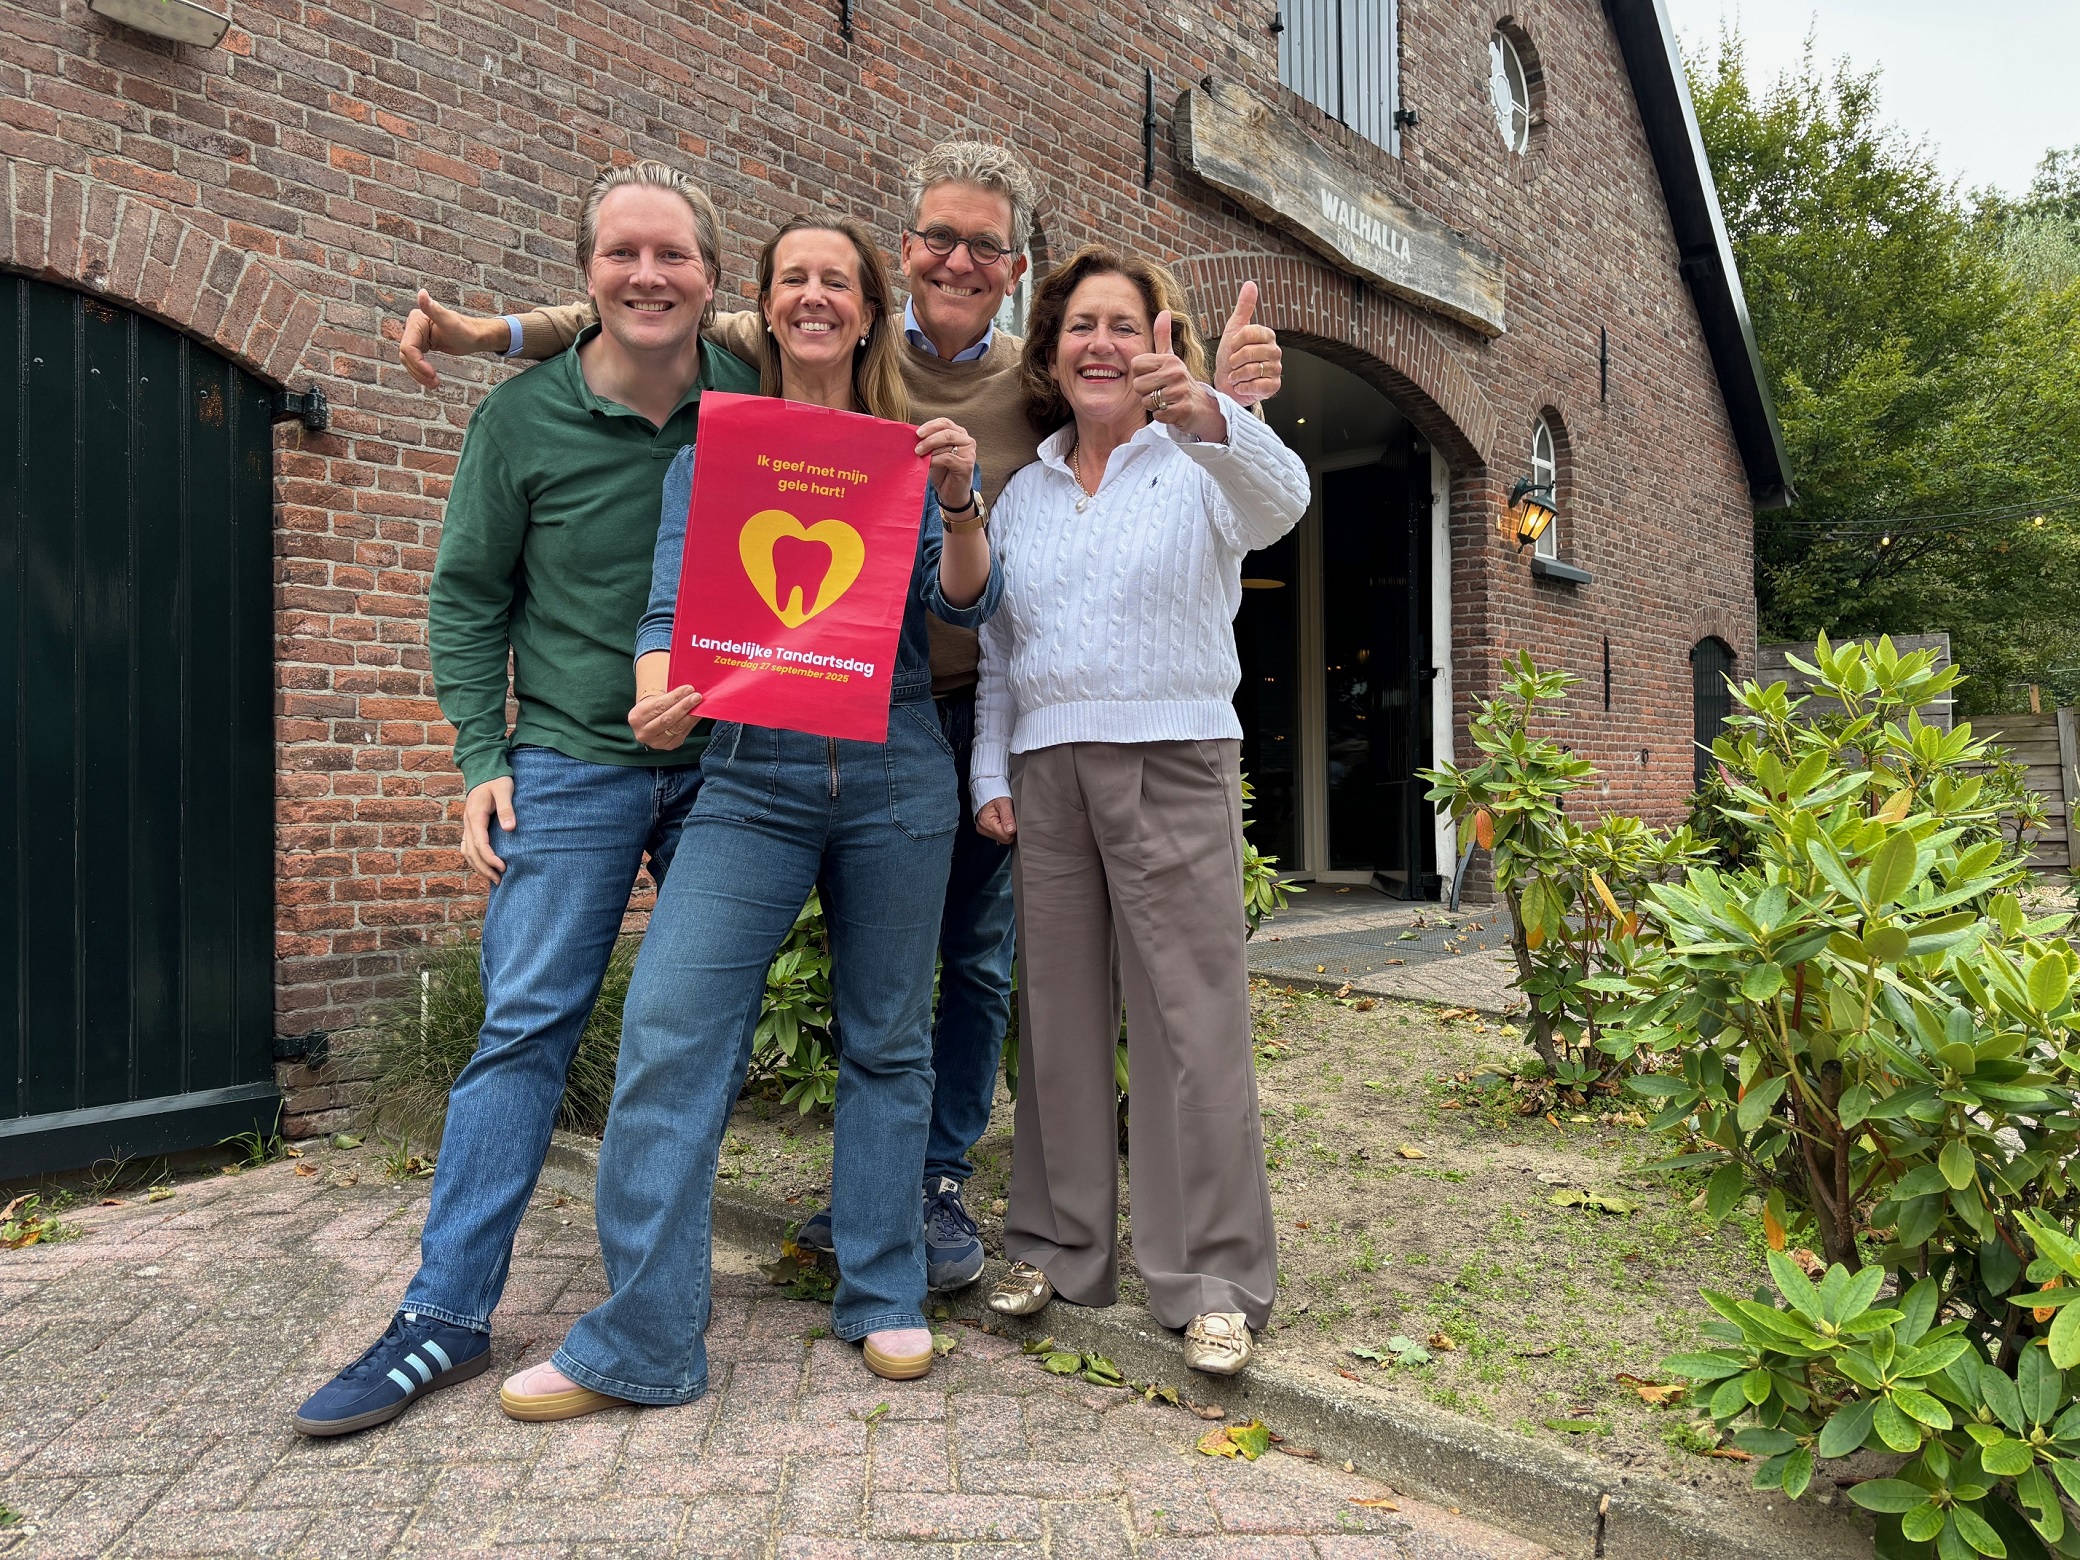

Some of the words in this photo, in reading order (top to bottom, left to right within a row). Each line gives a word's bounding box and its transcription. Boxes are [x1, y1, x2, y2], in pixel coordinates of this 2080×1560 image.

[1320, 188, 1411, 264] WALHALLA
[757, 454, 770, 467] Ik
[772, 459, 805, 472] geef
[806, 464, 835, 478] met
[837, 469, 868, 485] mijn
[778, 479, 808, 492] gele
[810, 482, 846, 498] hart!
[691, 634, 773, 660] Landelijke
[775, 647, 875, 678] Tandartsdag
[713, 655, 759, 672] Zaterdag
[759, 662, 771, 671] 27
[770, 664, 824, 679] september
[825, 671, 850, 683] 2025
